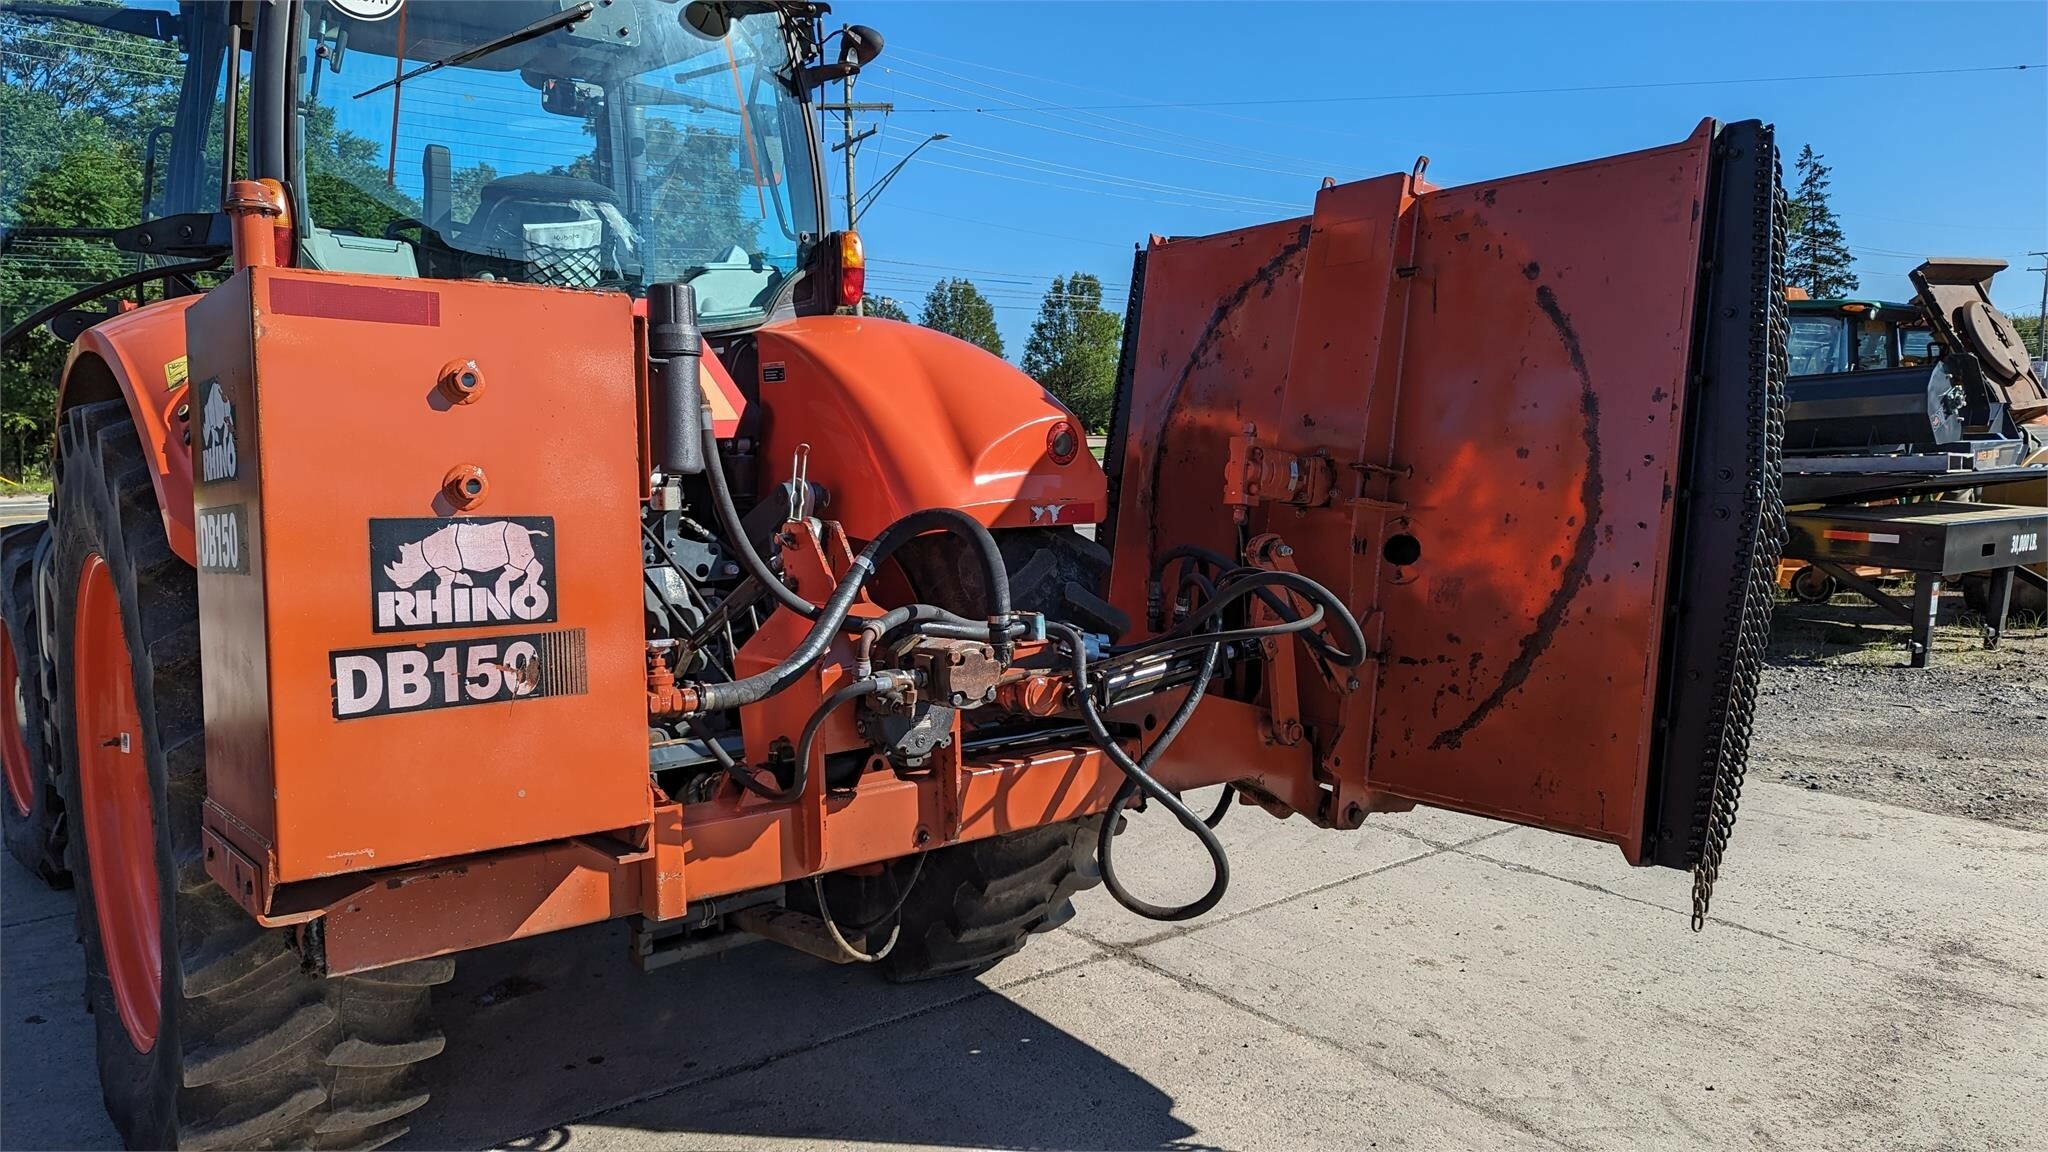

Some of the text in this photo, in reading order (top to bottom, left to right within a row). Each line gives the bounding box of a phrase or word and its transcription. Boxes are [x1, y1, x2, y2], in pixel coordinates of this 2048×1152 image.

[203, 440, 236, 482] RHINO
[200, 512, 238, 568] DB150
[378, 584, 549, 627] RHINO
[335, 641, 541, 715] DB150
